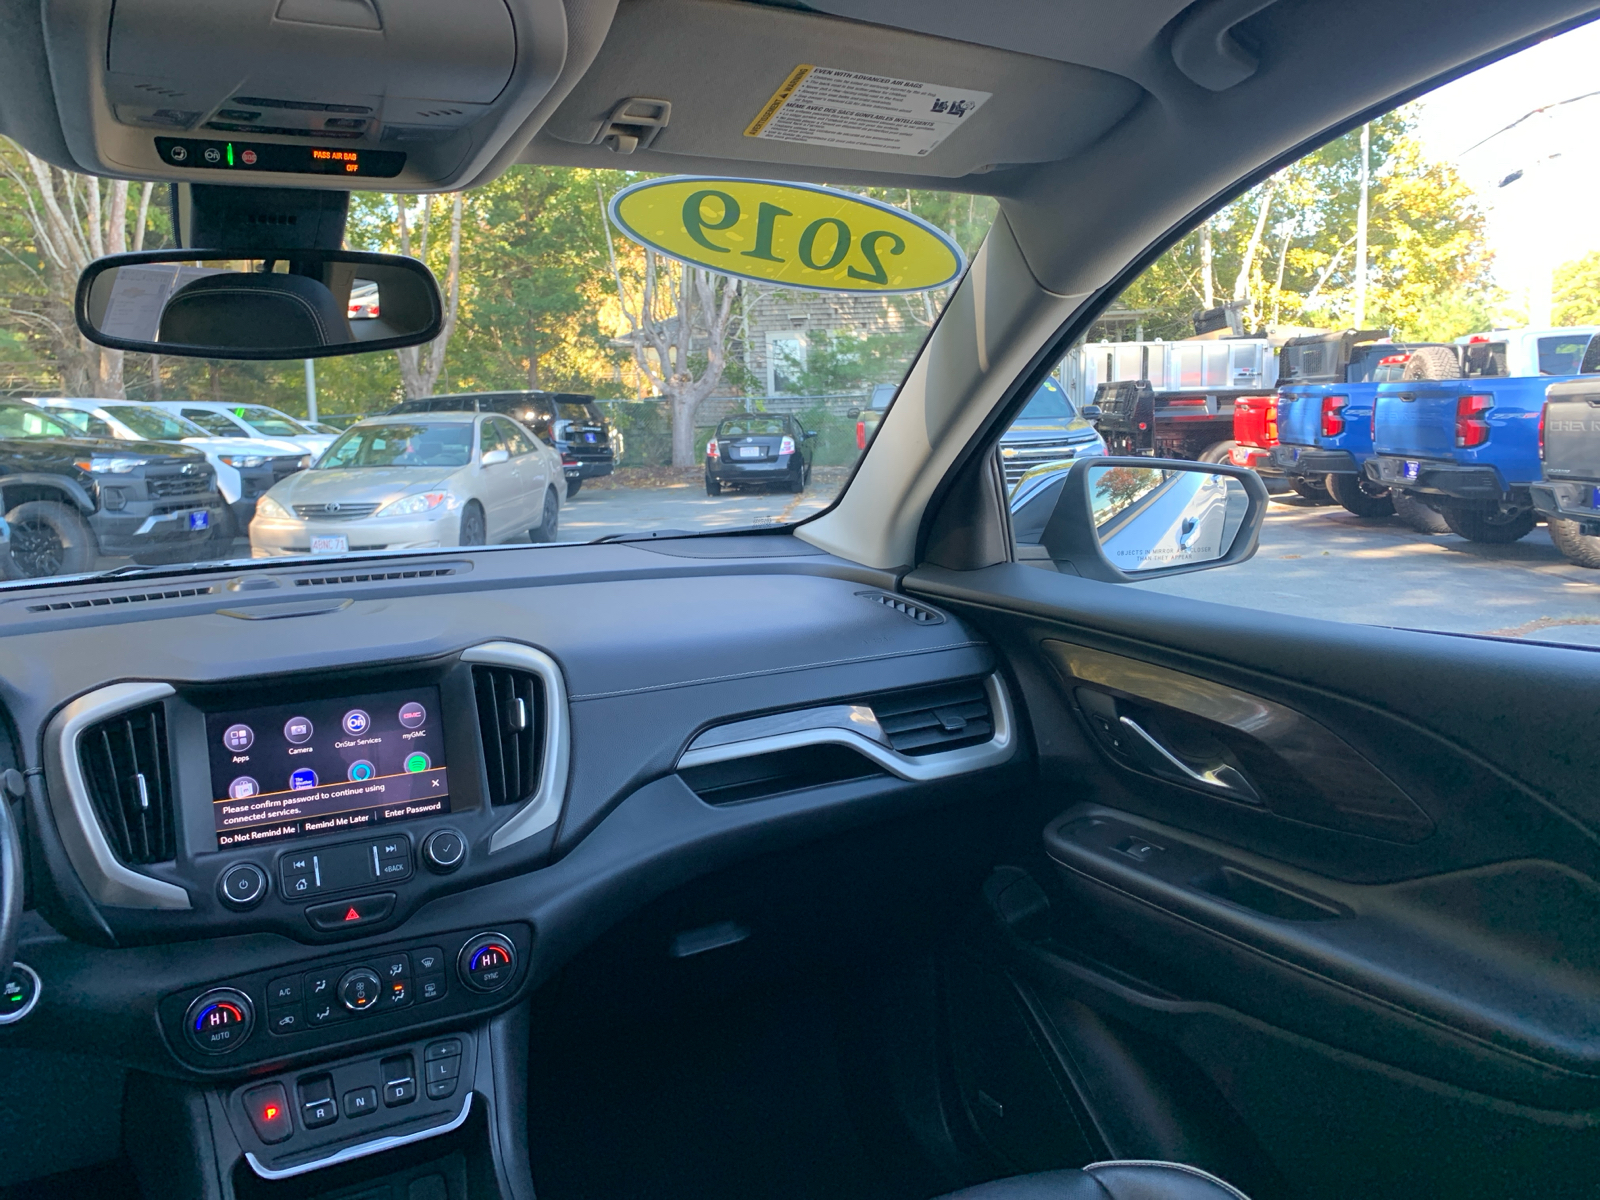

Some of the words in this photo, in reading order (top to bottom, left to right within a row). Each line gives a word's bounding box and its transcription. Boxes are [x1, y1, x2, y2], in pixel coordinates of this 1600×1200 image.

[784, 68, 809, 92] WARNING
[853, 73, 890, 84] ADVANCED
[855, 110, 894, 121] GONFLABLES
[313, 150, 331, 159] PASS
[332, 152, 342, 160] AIR
[343, 152, 357, 161] BAG
[346, 164, 358, 172] OFF
[402, 730, 426, 740] myGMC
[335, 740, 356, 749] OnStar
[357, 737, 382, 746] Services
[288, 746, 313, 755] Camera
[232, 755, 250, 764] Apps
[222, 802, 249, 815] Please
[250, 796, 282, 810] confirm
[282, 792, 320, 807] password
[331, 788, 363, 799] continue
[365, 784, 385, 795] using
[385, 808, 404, 818] Enter
[406, 801, 441, 815] Password
[224, 812, 271, 825] connected
[272, 808, 301, 819] services.
[305, 819, 334, 831] Remind
[336, 818, 348, 826] Me
[350, 814, 369, 824] Later
[220, 836, 233, 844] Do
[235, 833, 250, 842] Not
[251, 828, 282, 840] Remind
[284, 826, 296, 834] Me
[388, 864, 404, 872] BACK
[482, 954, 497, 966] HI
[483, 971, 499, 981] SYNC
[279, 987, 291, 997] A/C
[210, 1011, 228, 1026] HI
[210, 1031, 230, 1042] AUTO
[440, 1064, 446, 1074] L
[396, 1087, 404, 1098] D
[356, 1096, 364, 1106] N
[265, 1106, 277, 1120] P
[316, 1109, 325, 1119] R
